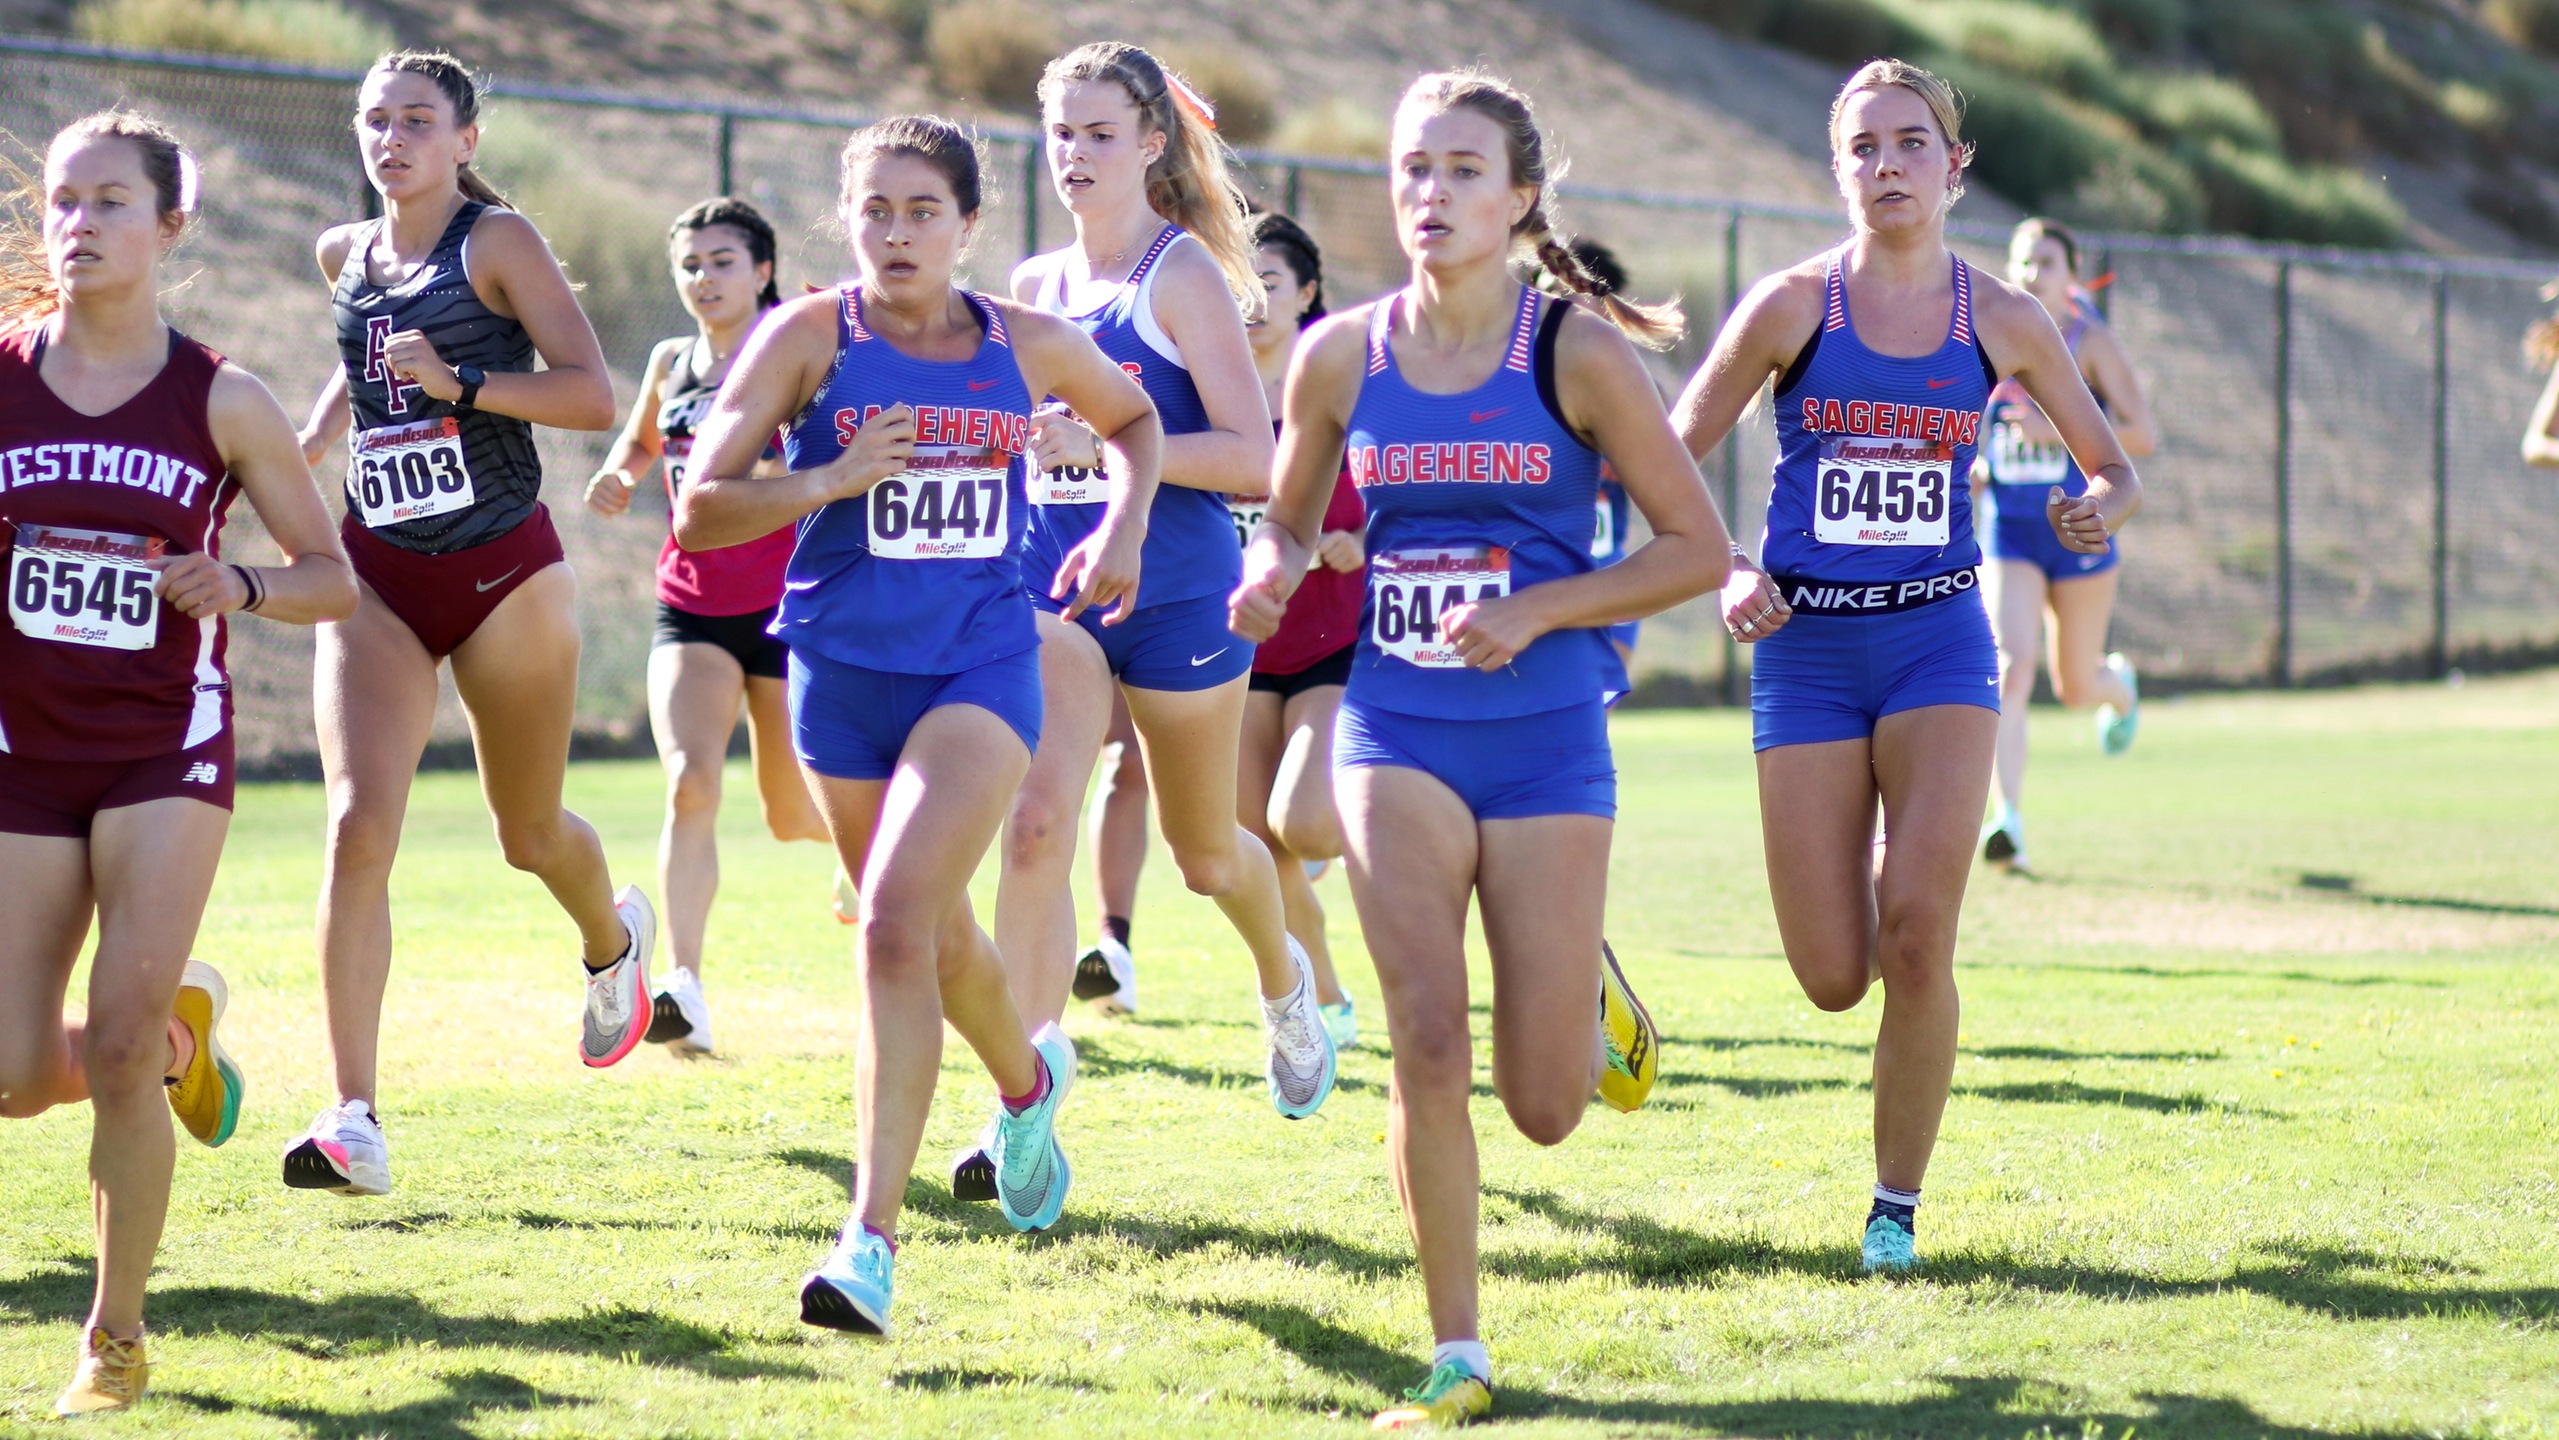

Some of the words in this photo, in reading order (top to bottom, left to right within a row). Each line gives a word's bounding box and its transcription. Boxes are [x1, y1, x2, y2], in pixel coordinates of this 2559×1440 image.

[834, 404, 1028, 454] SEHENS
[1803, 397, 1980, 446] SAGEHENS
[0, 443, 207, 508] ESTMONT
[361, 447, 465, 510] 6103
[1051, 488, 1086, 501] MileSplit
[1820, 468, 1945, 523] 6453
[393, 501, 435, 520] MileSplit
[872, 479, 1003, 541] 6447
[914, 541, 967, 556] MileSplit
[1857, 529, 1908, 543] MileSplit
[14, 557, 153, 627] 6545
[1378, 583, 1501, 643] 64
[1791, 585, 1891, 609] NIKE
[1897, 569, 1975, 604] PRO
[53, 623, 109, 642] MileSplit
